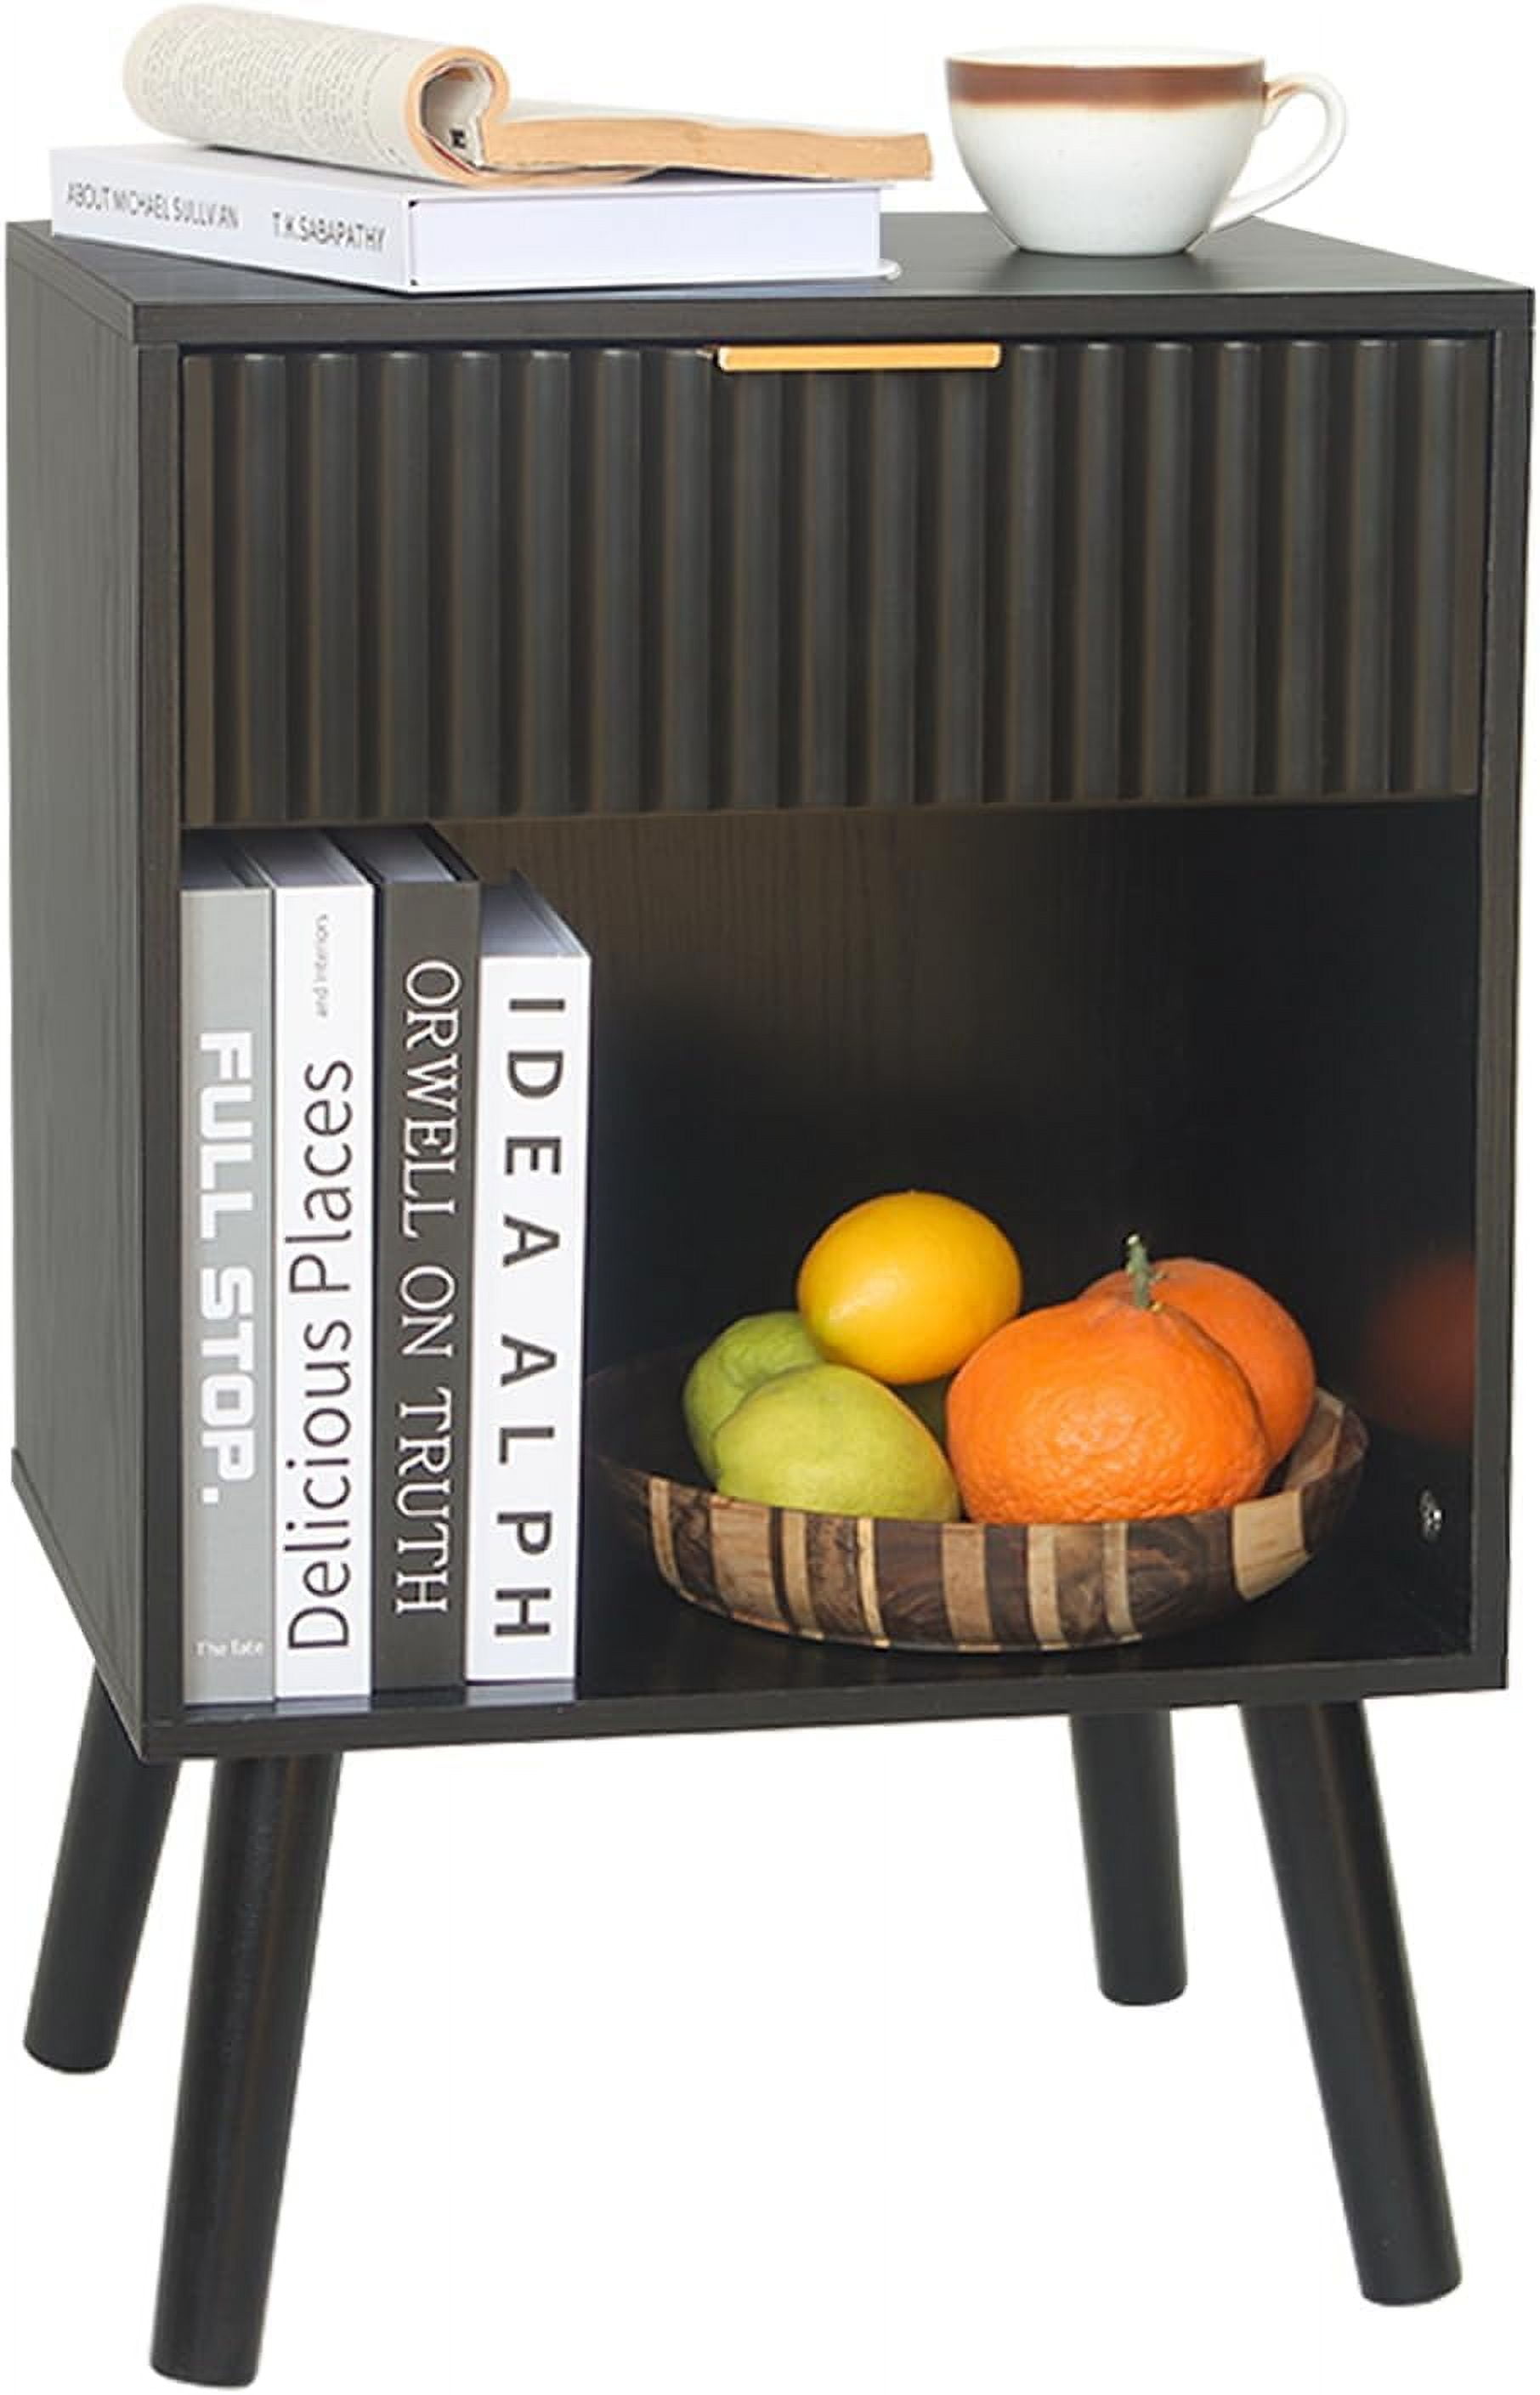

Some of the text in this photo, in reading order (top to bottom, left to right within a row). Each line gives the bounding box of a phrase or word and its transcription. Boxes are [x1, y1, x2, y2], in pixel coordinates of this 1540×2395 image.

[67, 182, 110, 212] ABOUT
[112, 190, 170, 222] MICHAEL
[201, 1031, 253, 1503] FULL STOP.
[284, 1060, 353, 1649] Delicious Places
[394, 959, 461, 1615] ORWELL ON TRUTH
[495, 999, 565, 1637] IDEA ALPH
